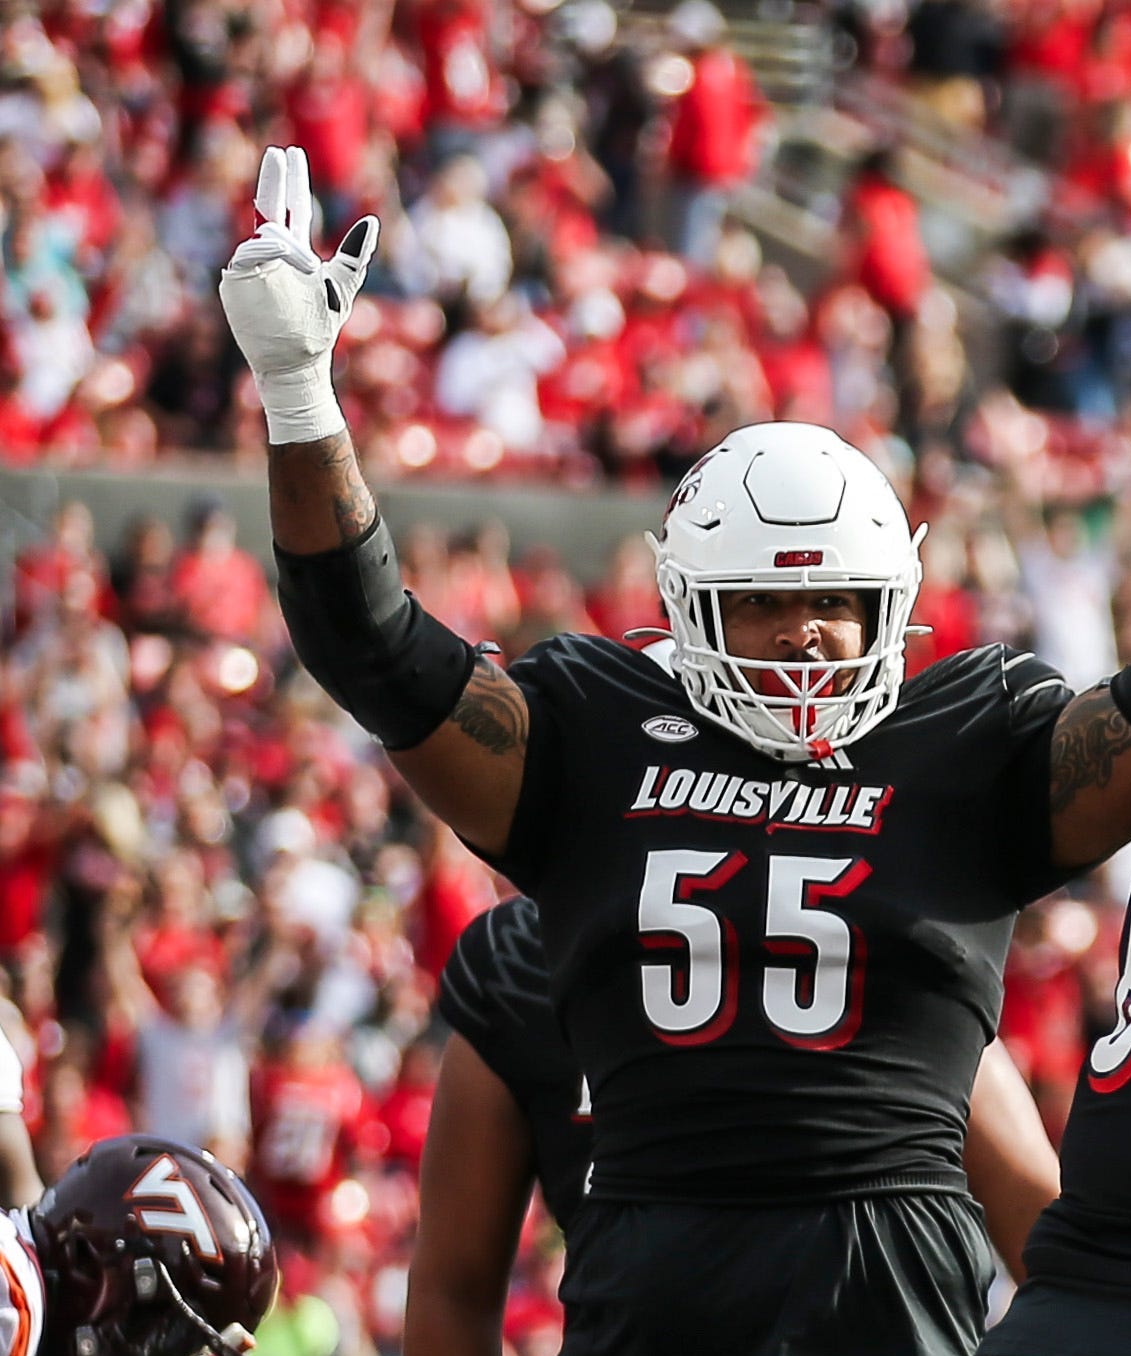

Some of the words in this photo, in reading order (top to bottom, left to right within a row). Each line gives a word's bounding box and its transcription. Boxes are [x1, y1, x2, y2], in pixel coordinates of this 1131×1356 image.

[652, 721, 690, 736] ACC
[628, 765, 890, 832] LOUISVILLE
[639, 848, 866, 1046] 55
